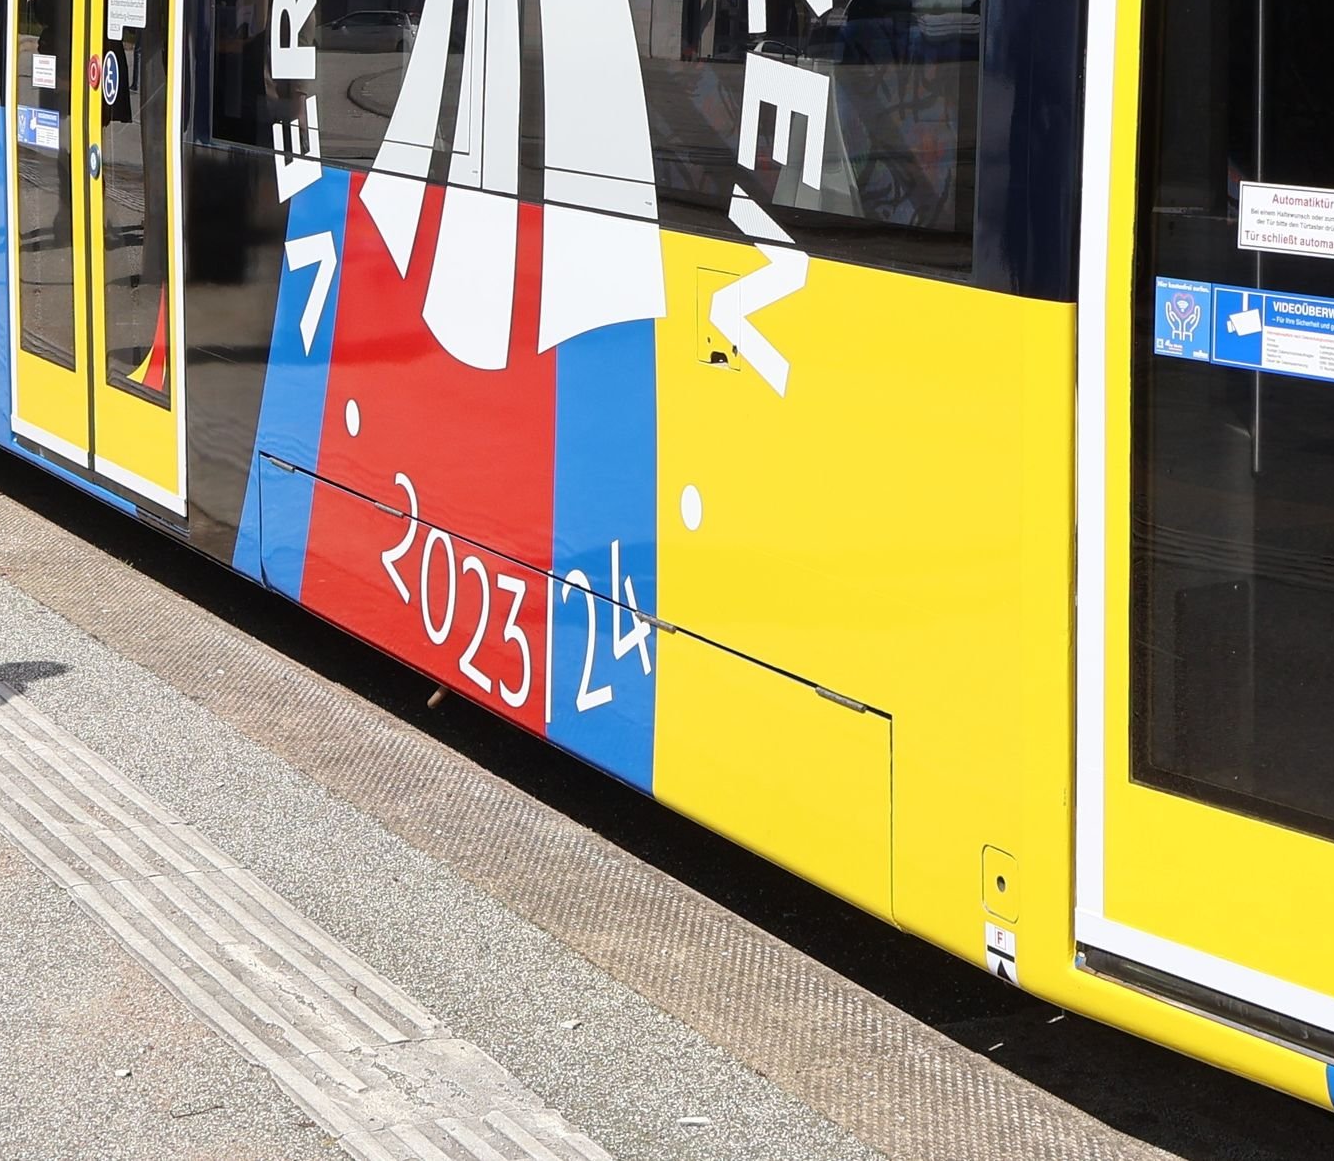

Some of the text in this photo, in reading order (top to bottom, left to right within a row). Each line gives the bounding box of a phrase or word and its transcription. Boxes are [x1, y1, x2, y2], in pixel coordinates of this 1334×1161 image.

[1271, 193, 1334, 210] Automatiktür
[1244, 229, 1260, 241] Tür
[1261, 232, 1298, 245] schließt
[1276, 316, 1286, 324] Für
[1285, 317, 1296, 325] Ihre
[1295, 318, 1320, 328] Sicherheit
[1320, 322, 1330, 330] und
[996, 930, 1004, 945] F
